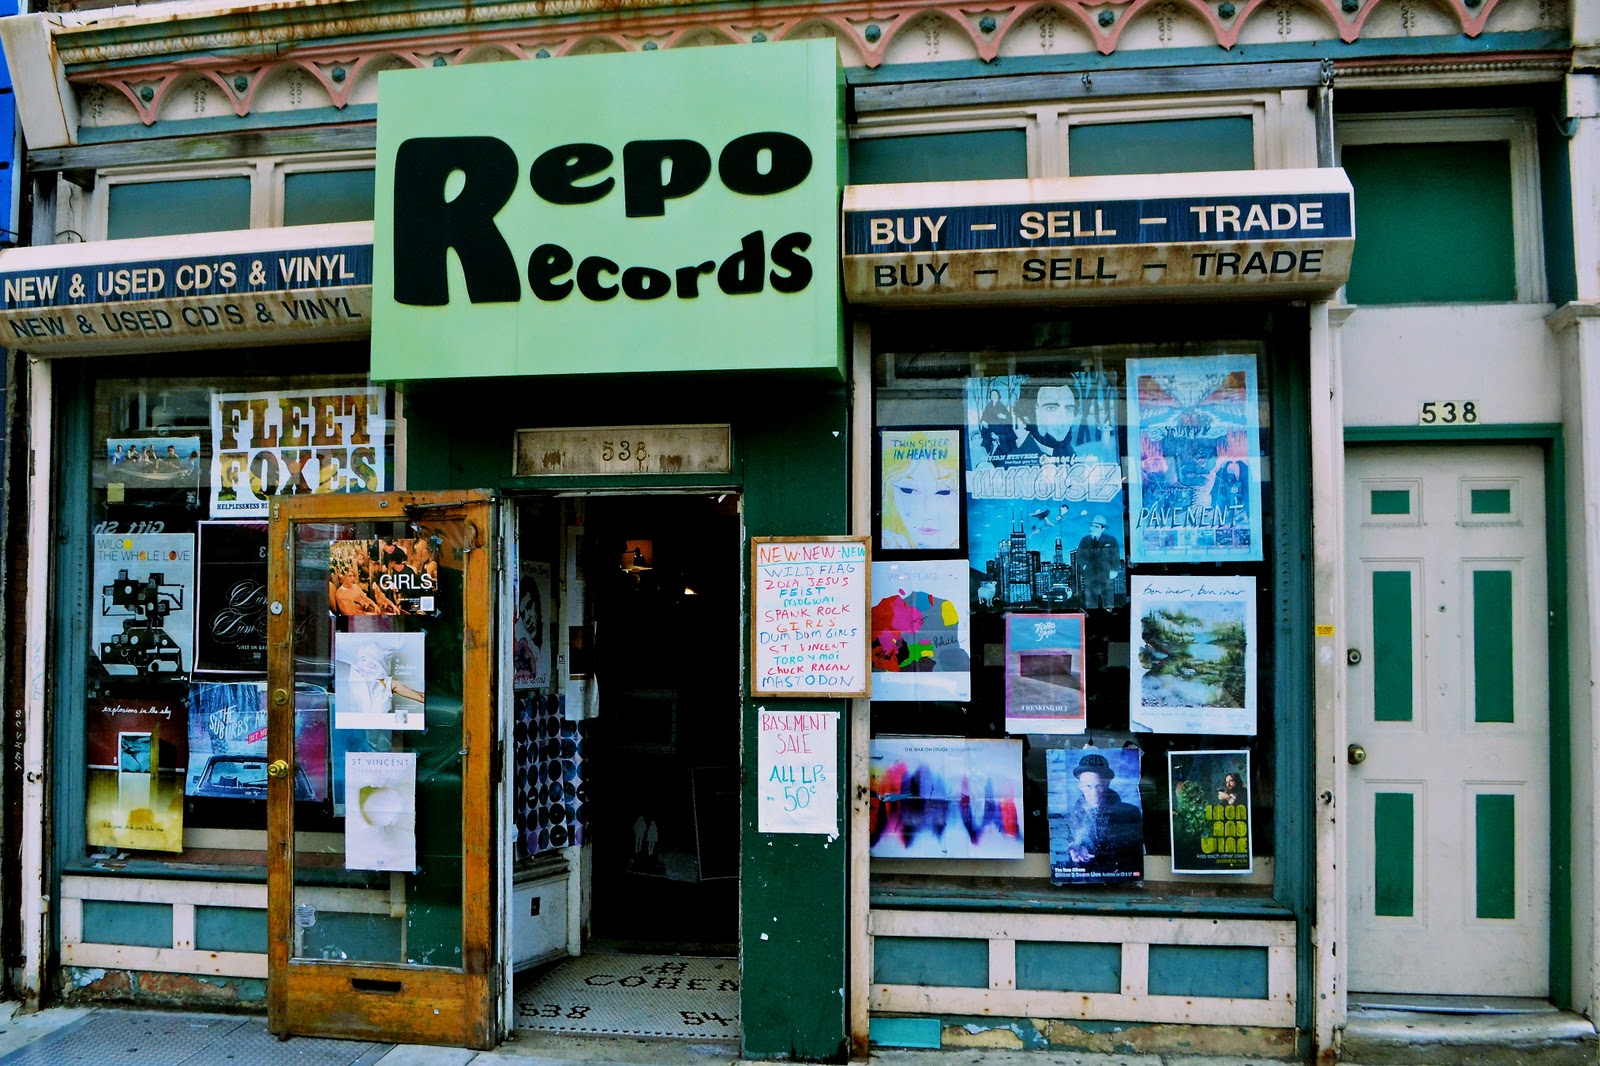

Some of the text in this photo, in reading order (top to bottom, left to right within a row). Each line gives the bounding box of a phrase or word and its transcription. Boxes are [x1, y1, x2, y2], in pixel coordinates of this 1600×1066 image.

[870, 215, 947, 245] BUY
[1020, 209, 1116, 240] SELL
[1190, 202, 1324, 233] TRADE
[874, 262, 949, 287] BUY
[1022, 256, 1117, 282] SELL
[1192, 249, 1324, 276] TRADE
[4, 254, 355, 303] NEW & USED CD'S & VINYL
[8, 297, 362, 338] NEW & USED CD'S & VINYL
[1421, 401, 1477, 424] 538
[219, 394, 378, 450] FLEET
[602, 440, 647, 461] 538
[893, 438, 949, 448] TWIN SISTER
[893, 448, 948, 461] IN HEAVEN
[218, 446, 378, 501] FOXES
[972, 464, 1119, 501] ILLINOISE
[217, 503, 260, 511] HELPLESSNESS
[1137, 498, 1244, 529] PAVEMENT
[98, 550, 190, 561] THE WHOLE LOVE
[760, 546, 866, 564] NEW NEW NEW
[764, 563, 855, 578] WILD FLAG
[912, 573, 937, 581] FLAG
[379, 573, 433, 590] GIRLS
[765, 577, 849, 590] ZOLA JESUS
[765, 604, 850, 622] SPANK ROCK
[776, 619, 836, 633] GIRLS
[760, 631, 791, 644] DUM
[800, 641, 848, 652] VINCENT
[774, 655, 804, 665] TORO
[762, 674, 853, 688] MASTODON
[102, 704, 138, 716] explosions
[159, 706, 171, 720] sky
[217, 705, 237, 723] THE
[209, 713, 249, 741] SUBURBS
[762, 713, 829, 731] BASEMENT
[775, 734, 813, 754] SALE
[352, 758, 408, 766] ST VINCENT
[769, 765, 795, 783] ALL
[1205, 804, 1246, 820] IRON
[1213, 820, 1247, 837] AND
[1201, 837, 1248, 854] WINE
[584, 974, 739, 992] COHEN
[518, 1002, 739, 1026] 538 54
